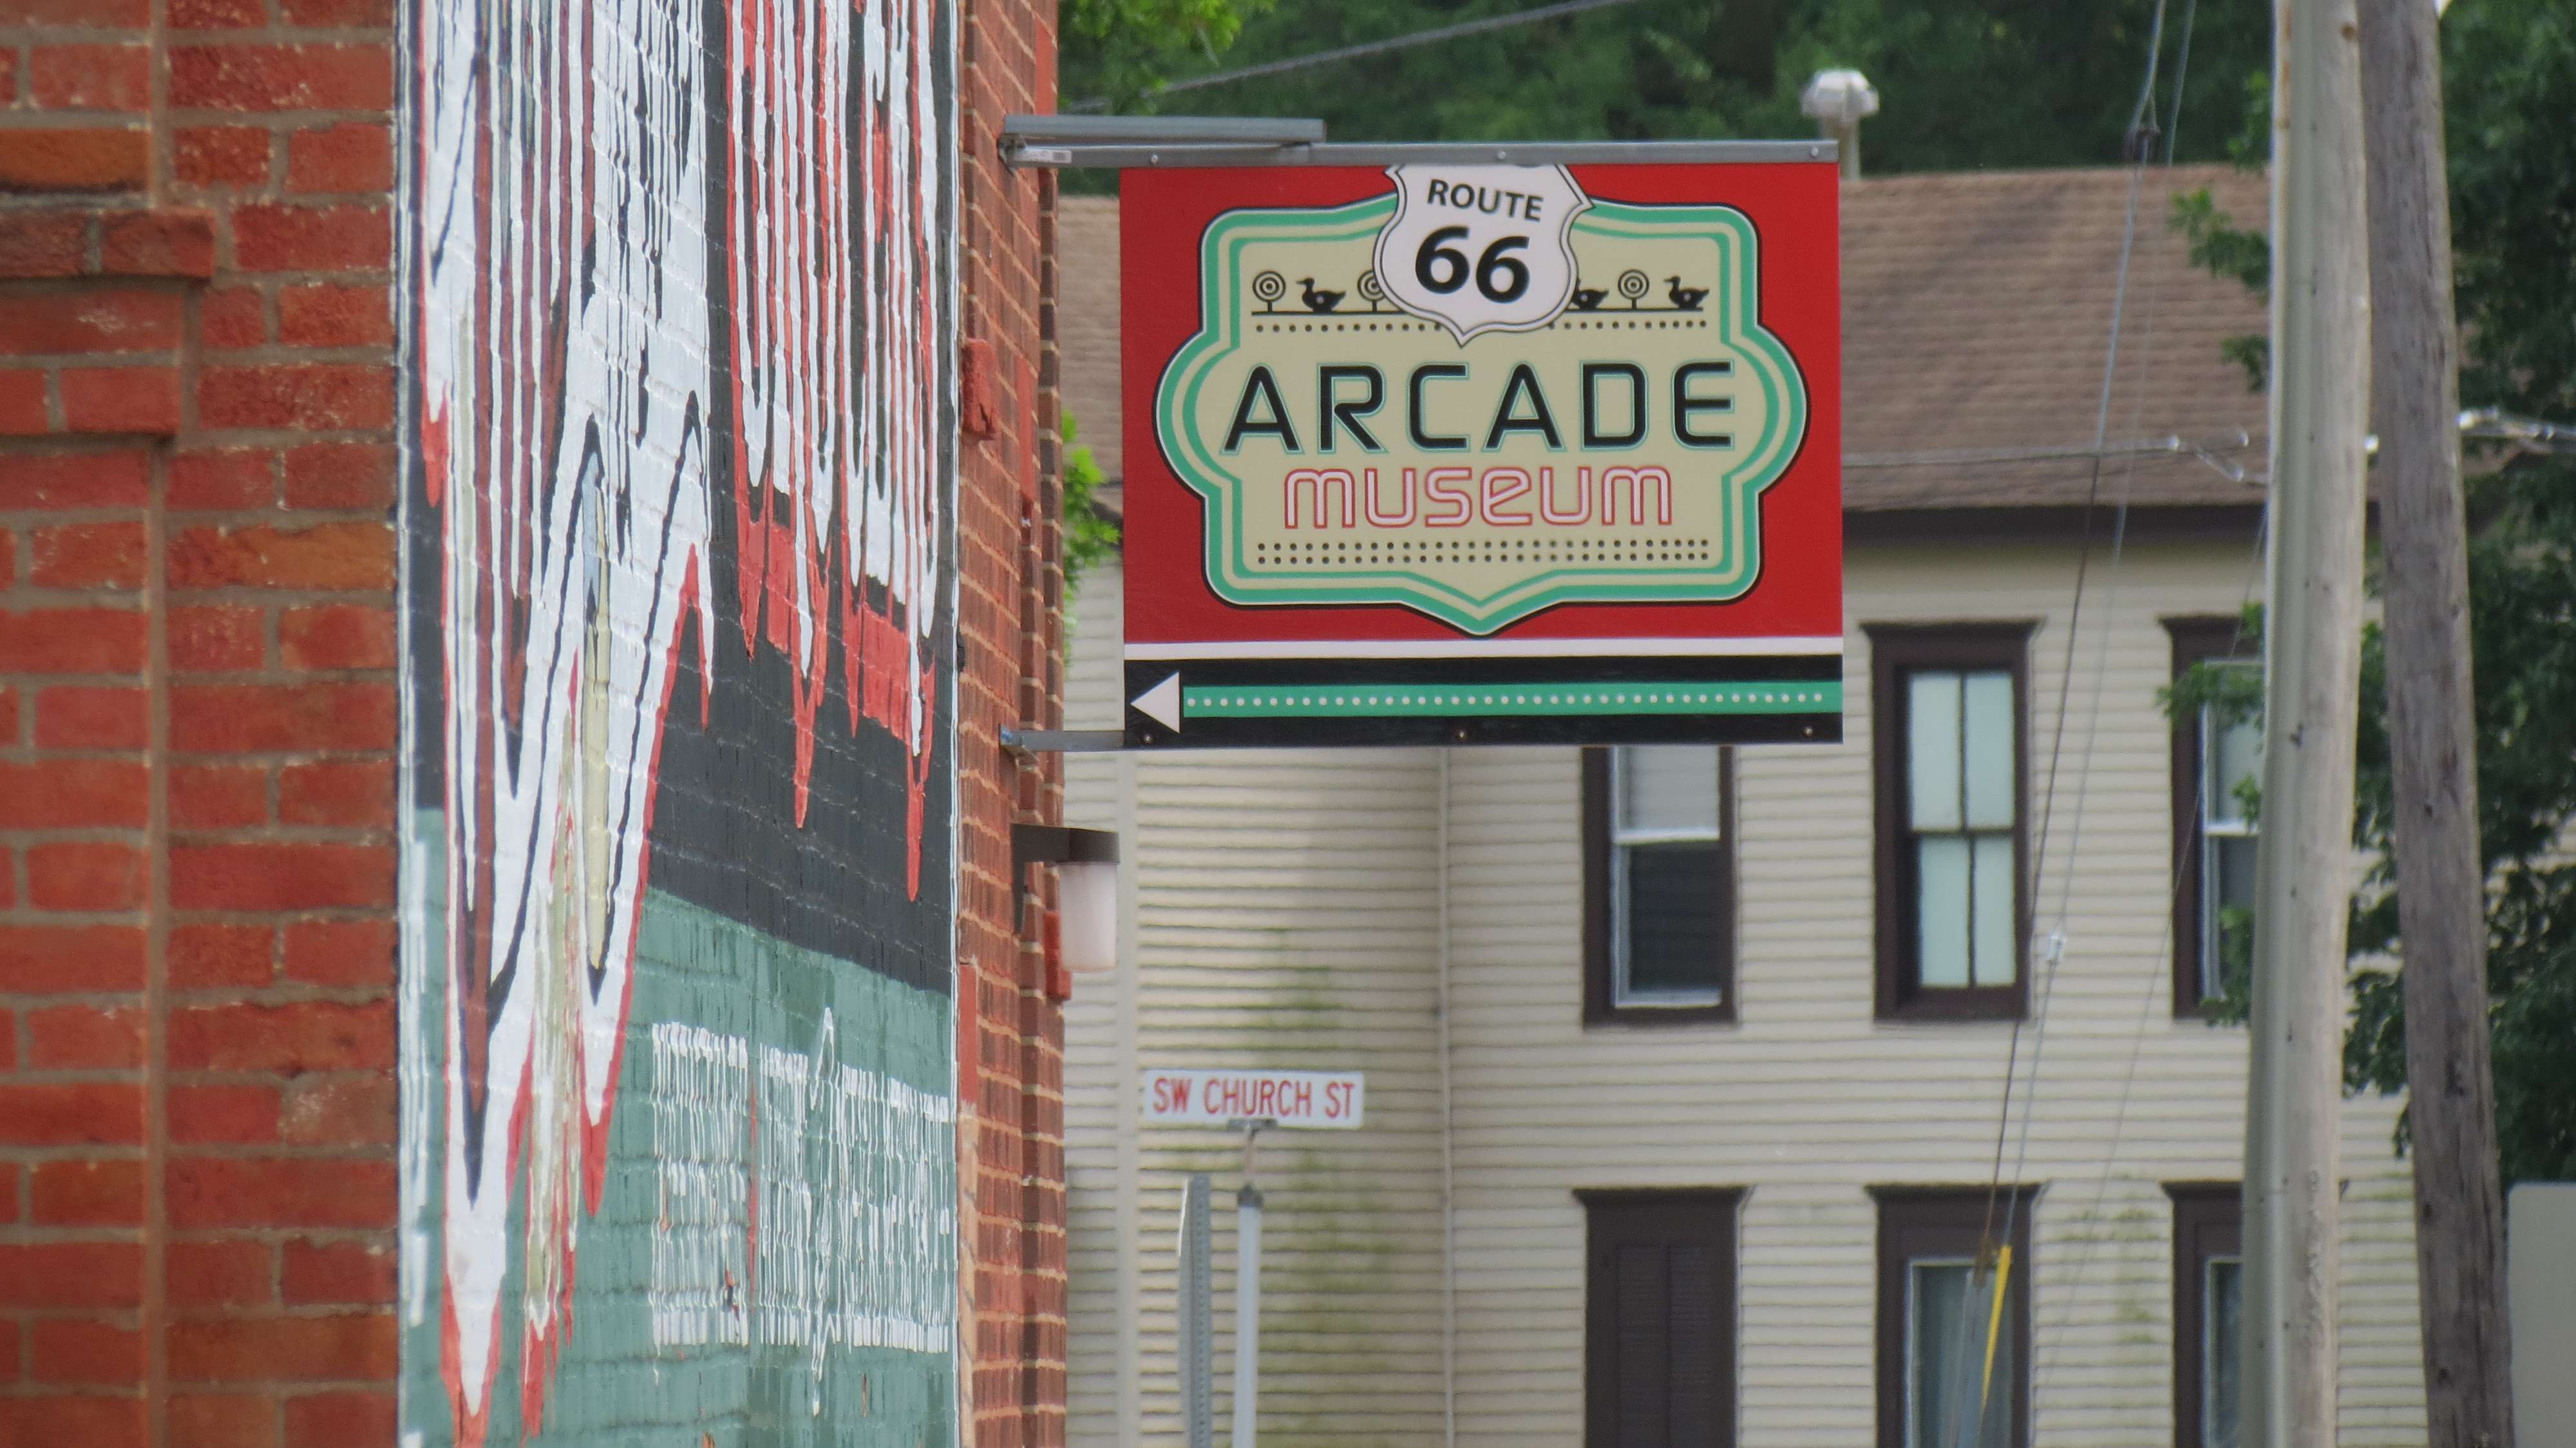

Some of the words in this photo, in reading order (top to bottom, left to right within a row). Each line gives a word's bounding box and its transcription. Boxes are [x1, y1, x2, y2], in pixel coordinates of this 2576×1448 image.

[1427, 178, 1543, 222] ROUTE
[1415, 225, 1531, 304] 66
[1219, 358, 1736, 455] ARCADE
[1153, 1077, 1192, 1114] SW
[1204, 1078, 1312, 1117] CHURCH
[1325, 1081, 1354, 1119] ST
